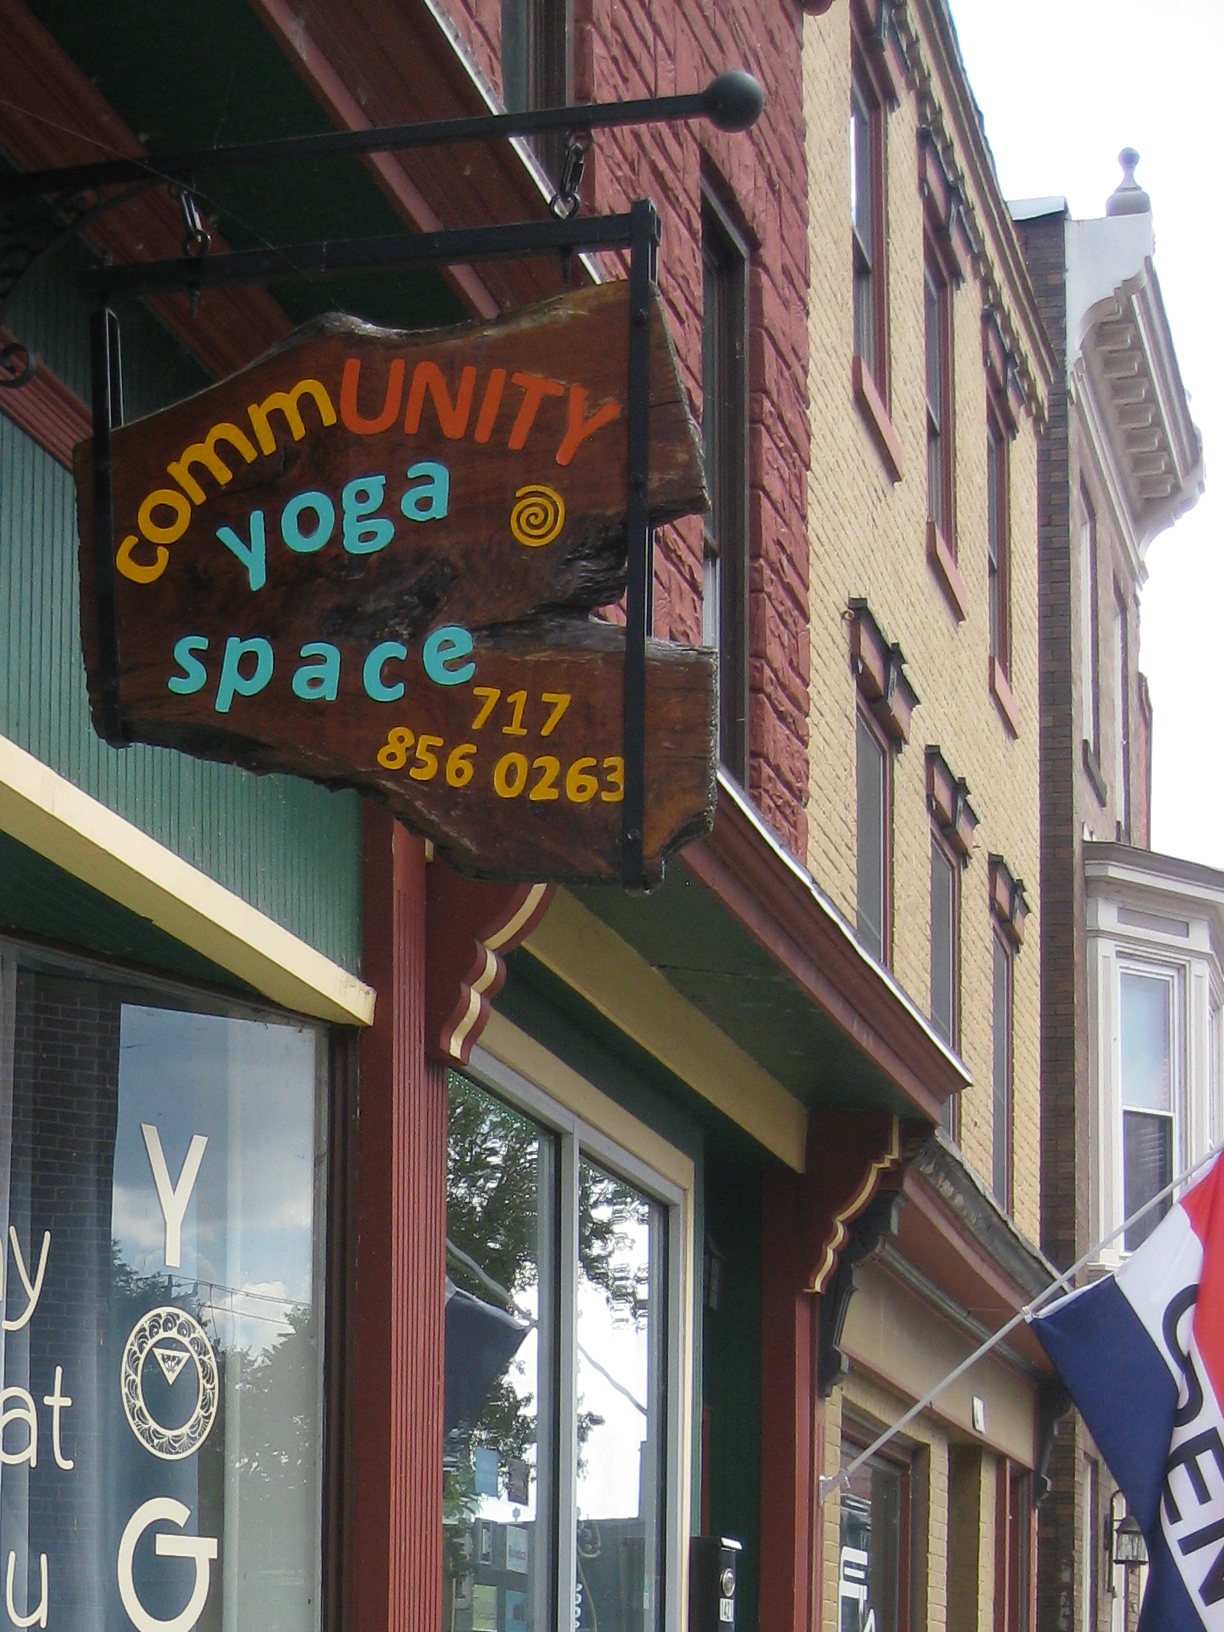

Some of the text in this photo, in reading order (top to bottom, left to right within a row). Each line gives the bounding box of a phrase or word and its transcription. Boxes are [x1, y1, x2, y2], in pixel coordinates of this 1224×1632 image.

[116, 358, 621, 584] commUNITY
[216, 461, 451, 591] yoga
[167, 625, 477, 713] space
[471, 686, 571, 737] 717
[377, 726, 624, 803] 856 0263
